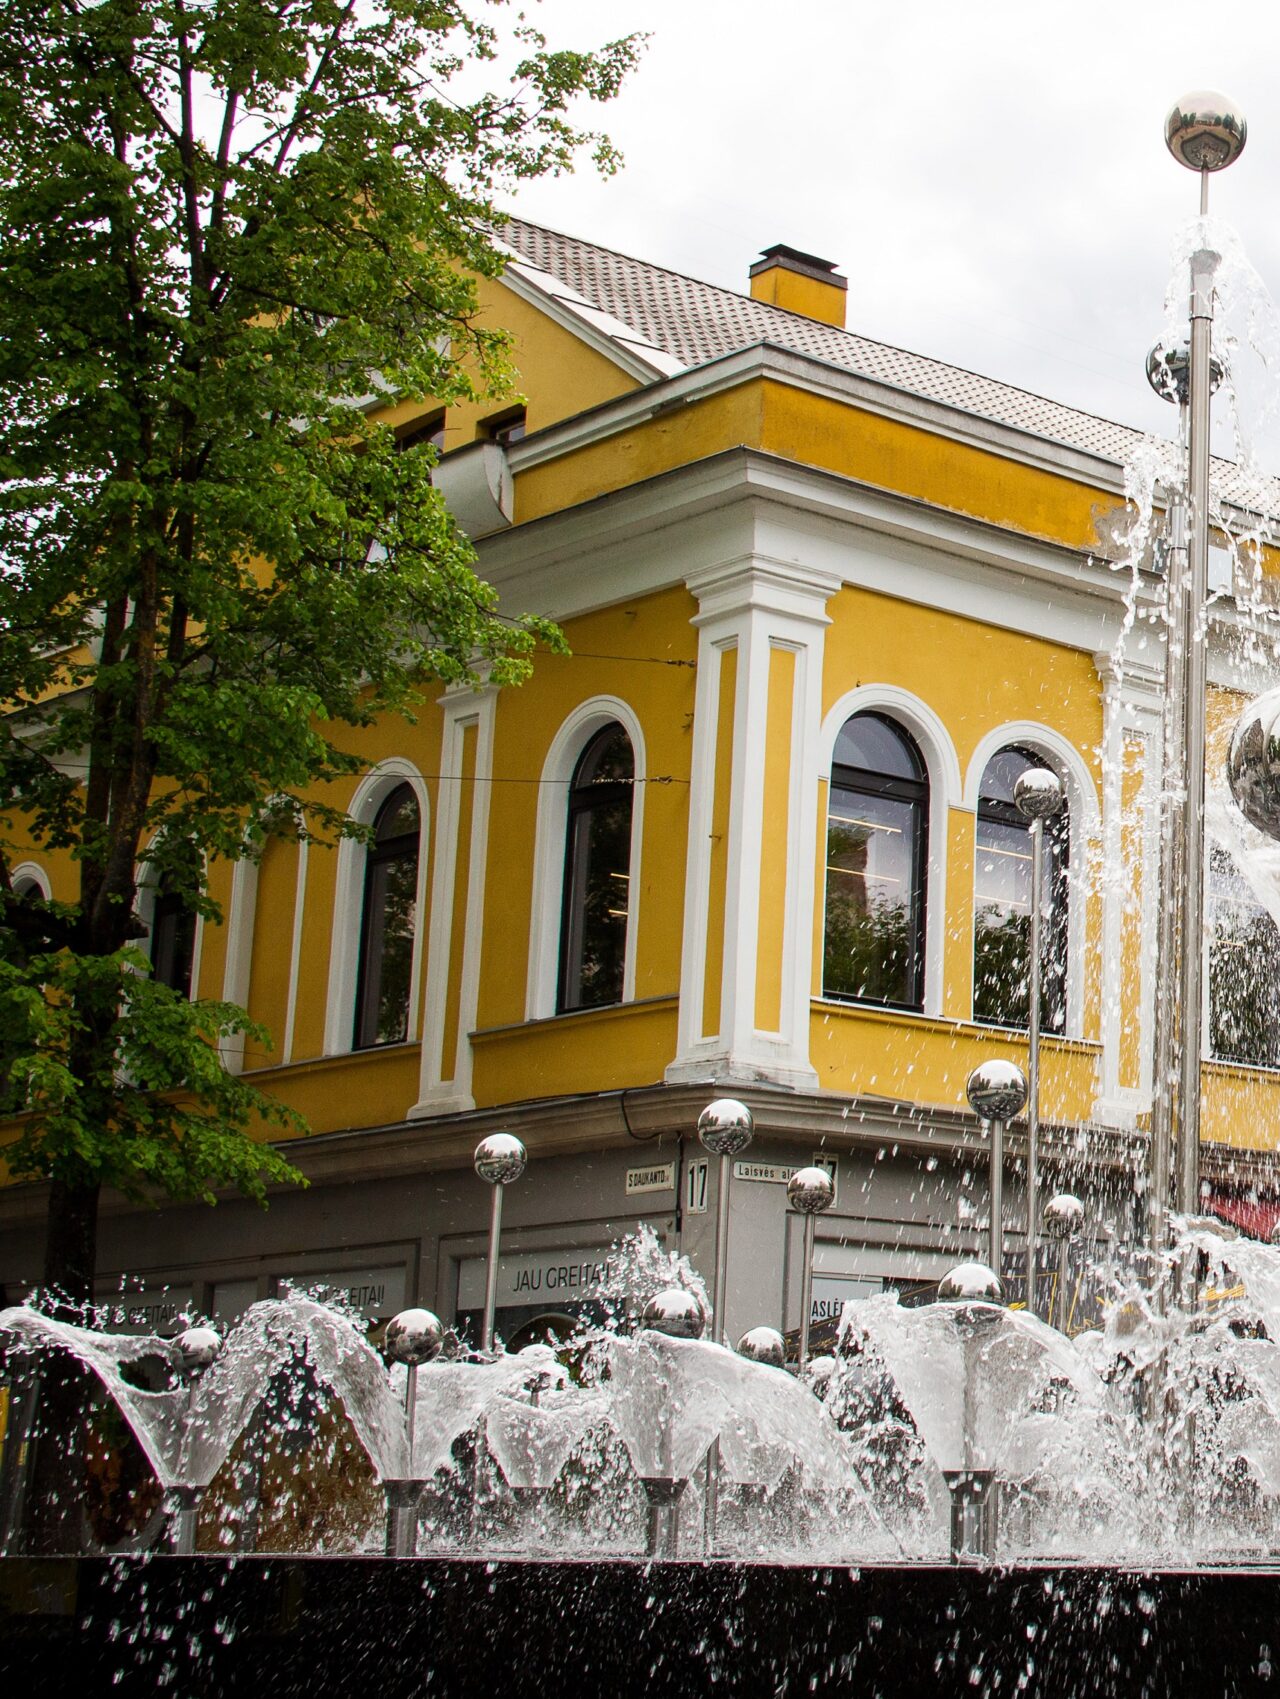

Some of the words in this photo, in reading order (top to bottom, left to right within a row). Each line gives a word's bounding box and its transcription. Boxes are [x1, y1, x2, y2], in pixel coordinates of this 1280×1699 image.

[739, 1164, 775, 1178] Laisvės
[689, 1163, 708, 1207] 17
[513, 1269, 541, 1292] JAU
